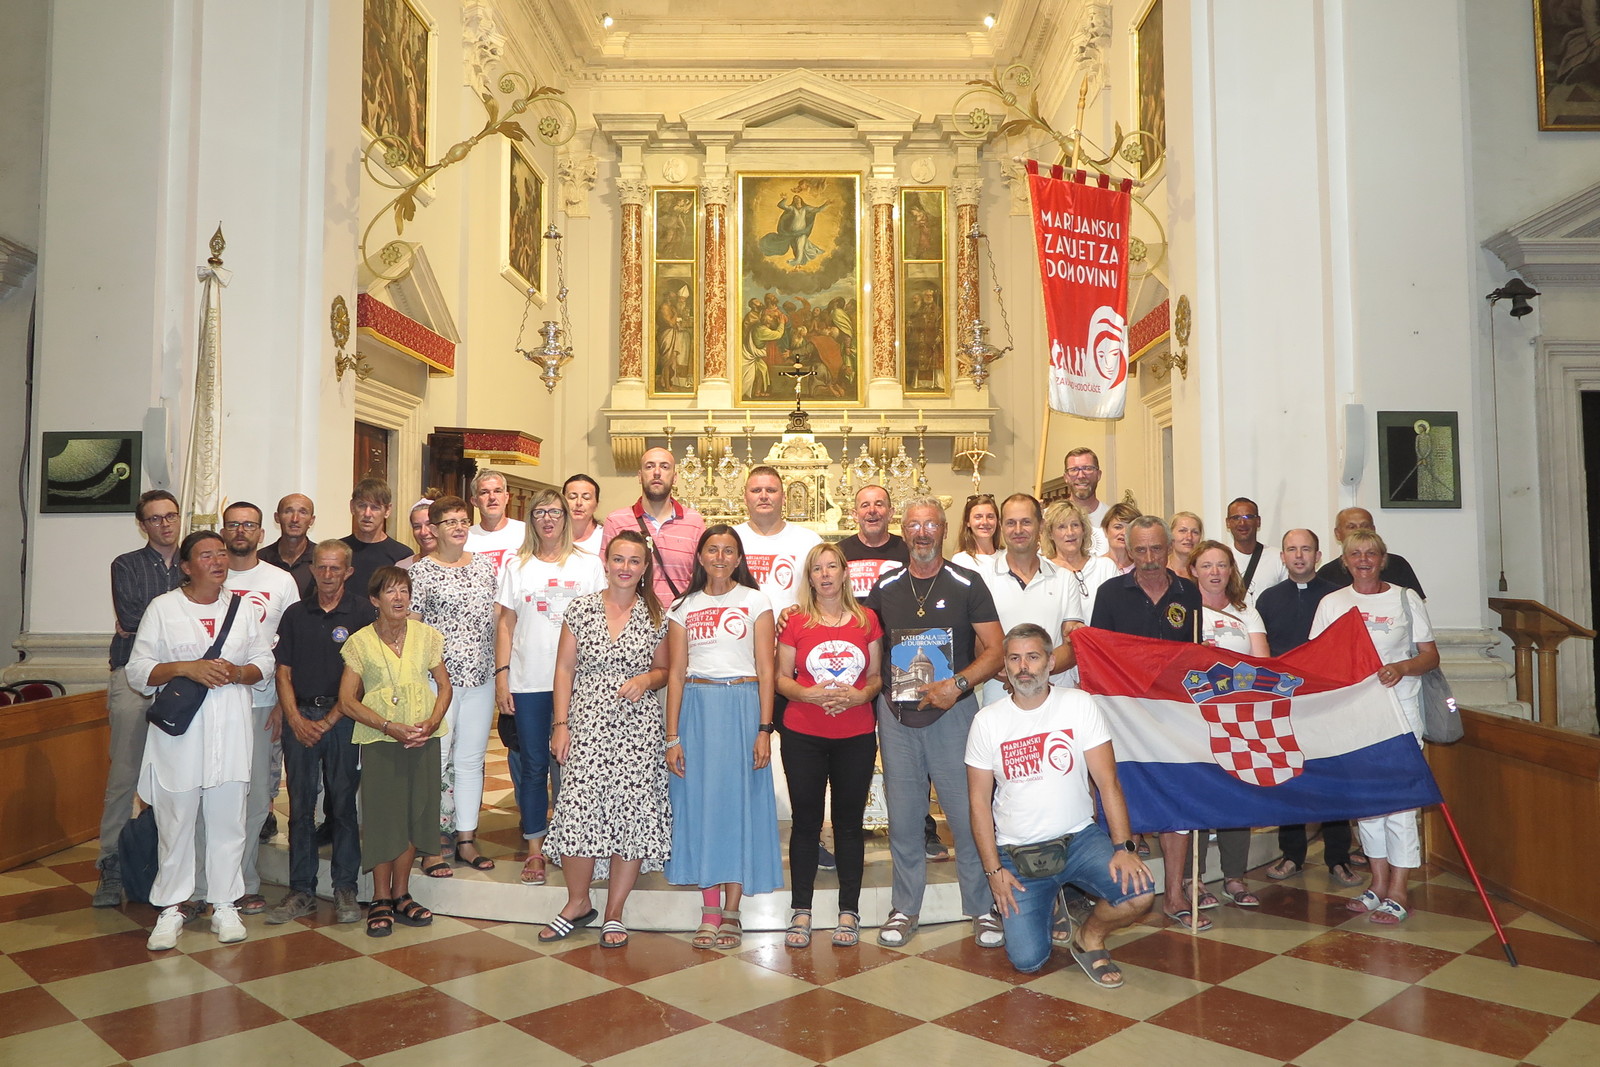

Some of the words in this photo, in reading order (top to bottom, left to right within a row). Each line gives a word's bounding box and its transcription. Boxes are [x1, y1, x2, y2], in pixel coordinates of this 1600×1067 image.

[1041, 209, 1120, 240] MARIJANSKI
[1044, 233, 1096, 261] ZAVJET
[1099, 243, 1119, 265] ZA
[1046, 258, 1118, 289] DOMOVINU
[208, 307, 217, 369] BRATSTVO
[203, 416, 214, 496] SAKRAMENTA
[908, 639, 948, 647] DUBROVNIKU
[1003, 736, 1041, 751] MARIJANSKI
[1005, 747, 1027, 759] ZAVJET
[1005, 752, 1040, 766] DOMOVINU
